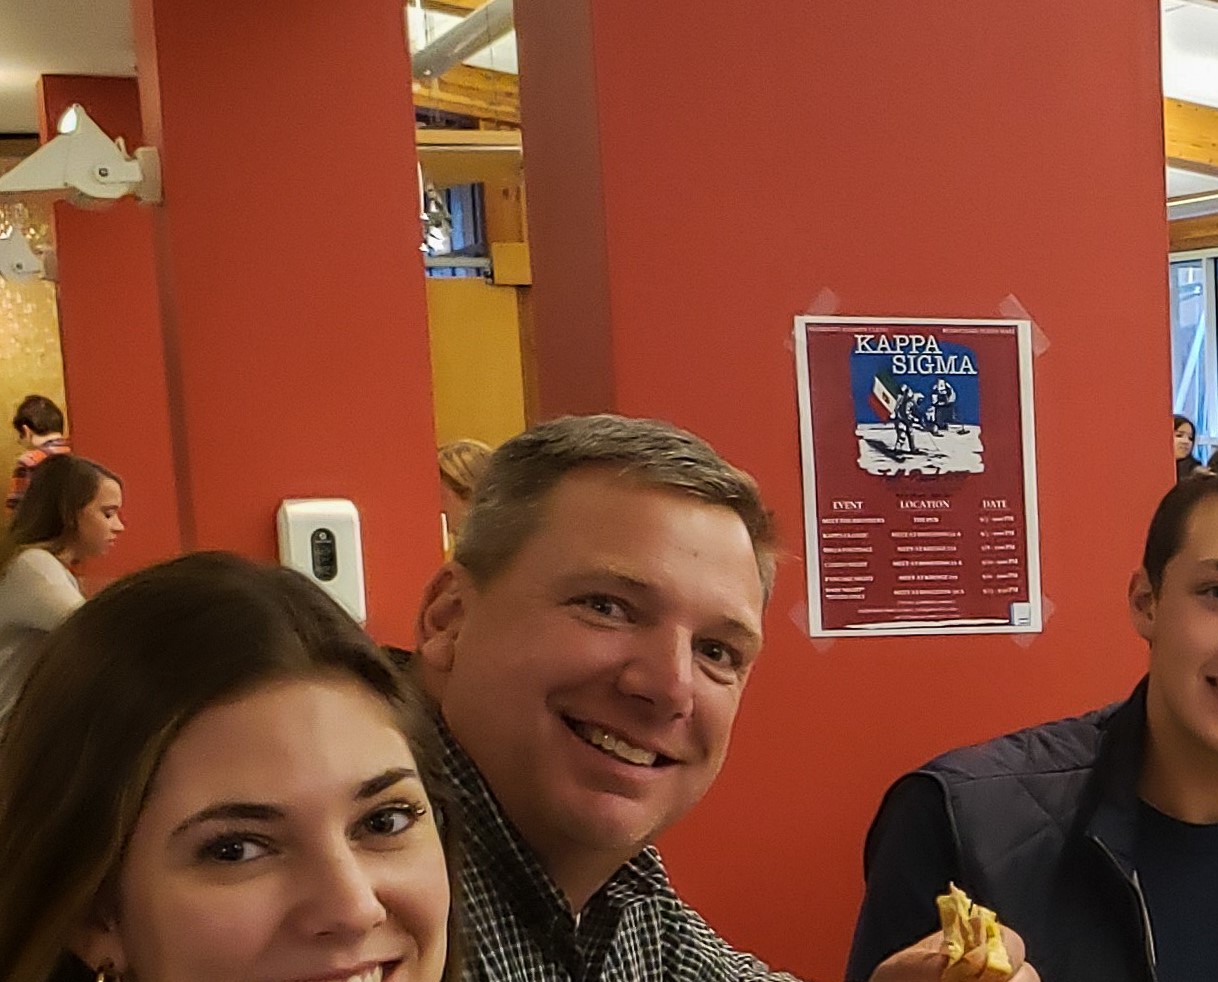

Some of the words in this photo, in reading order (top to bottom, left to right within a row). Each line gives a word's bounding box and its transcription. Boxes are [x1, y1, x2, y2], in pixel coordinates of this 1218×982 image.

[853, 333, 943, 354] KAPPA
[891, 354, 978, 375] SIGMA
[832, 500, 864, 510] EVENT
[899, 499, 951, 510] LOCATION
[982, 499, 1008, 510] DATE
